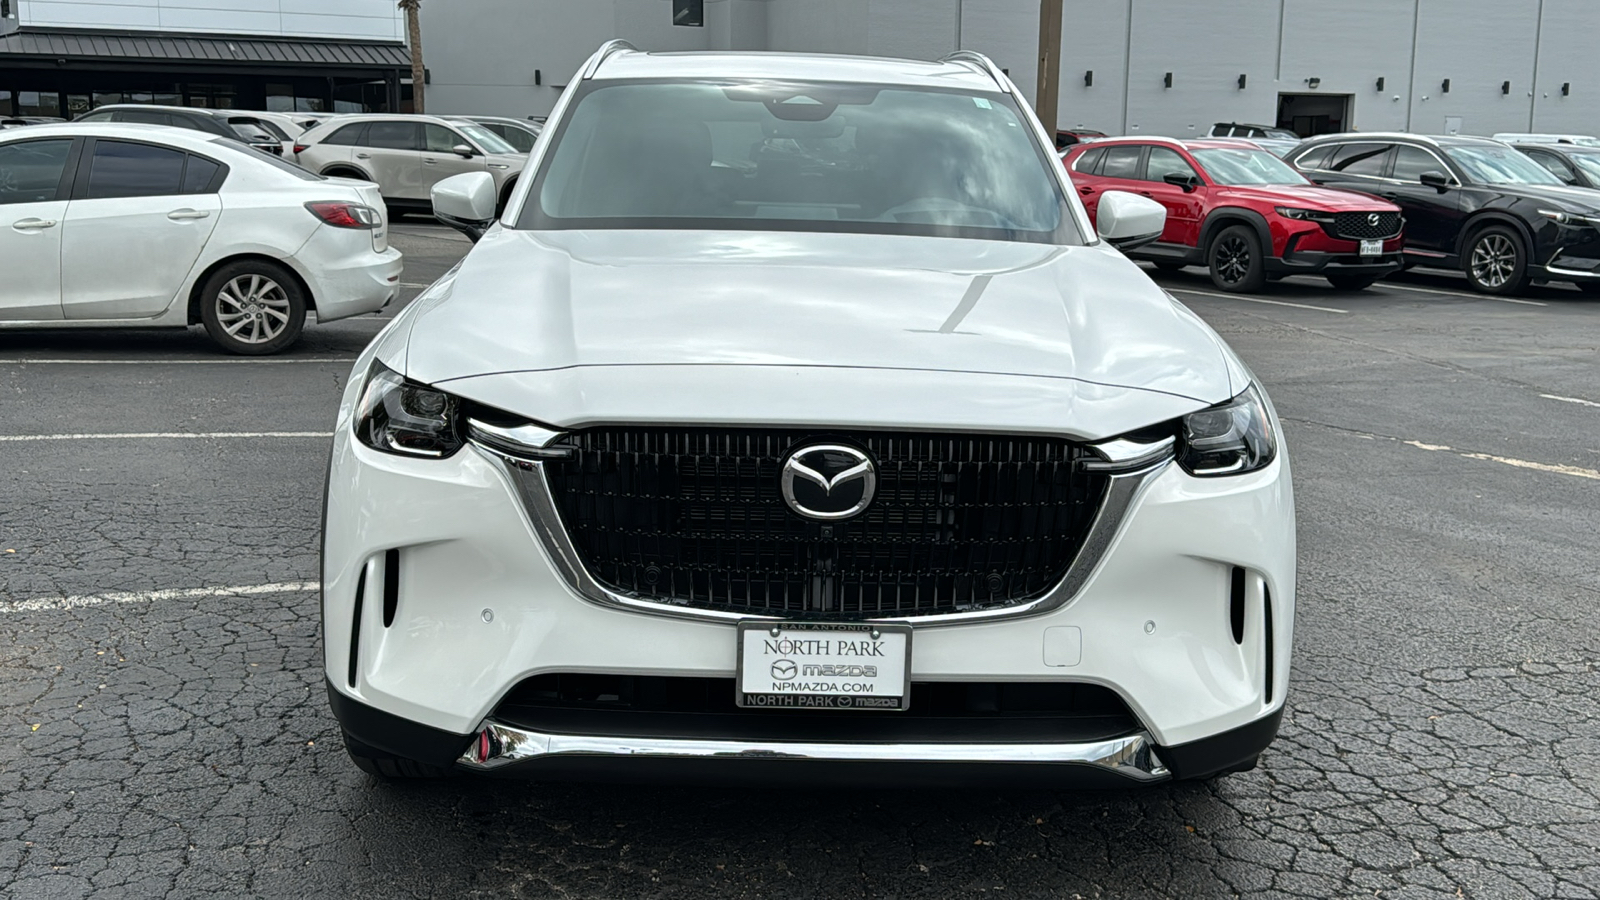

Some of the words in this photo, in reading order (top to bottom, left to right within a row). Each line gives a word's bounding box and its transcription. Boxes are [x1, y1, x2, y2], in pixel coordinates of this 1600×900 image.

[811, 624, 871, 632] ANTONIO
[764, 638, 830, 657] NORTH
[837, 641, 885, 657] PARK
[772, 682, 874, 693] NPMAZDA.COM
[747, 695, 794, 706] NORTH
[798, 697, 834, 707] PARK
